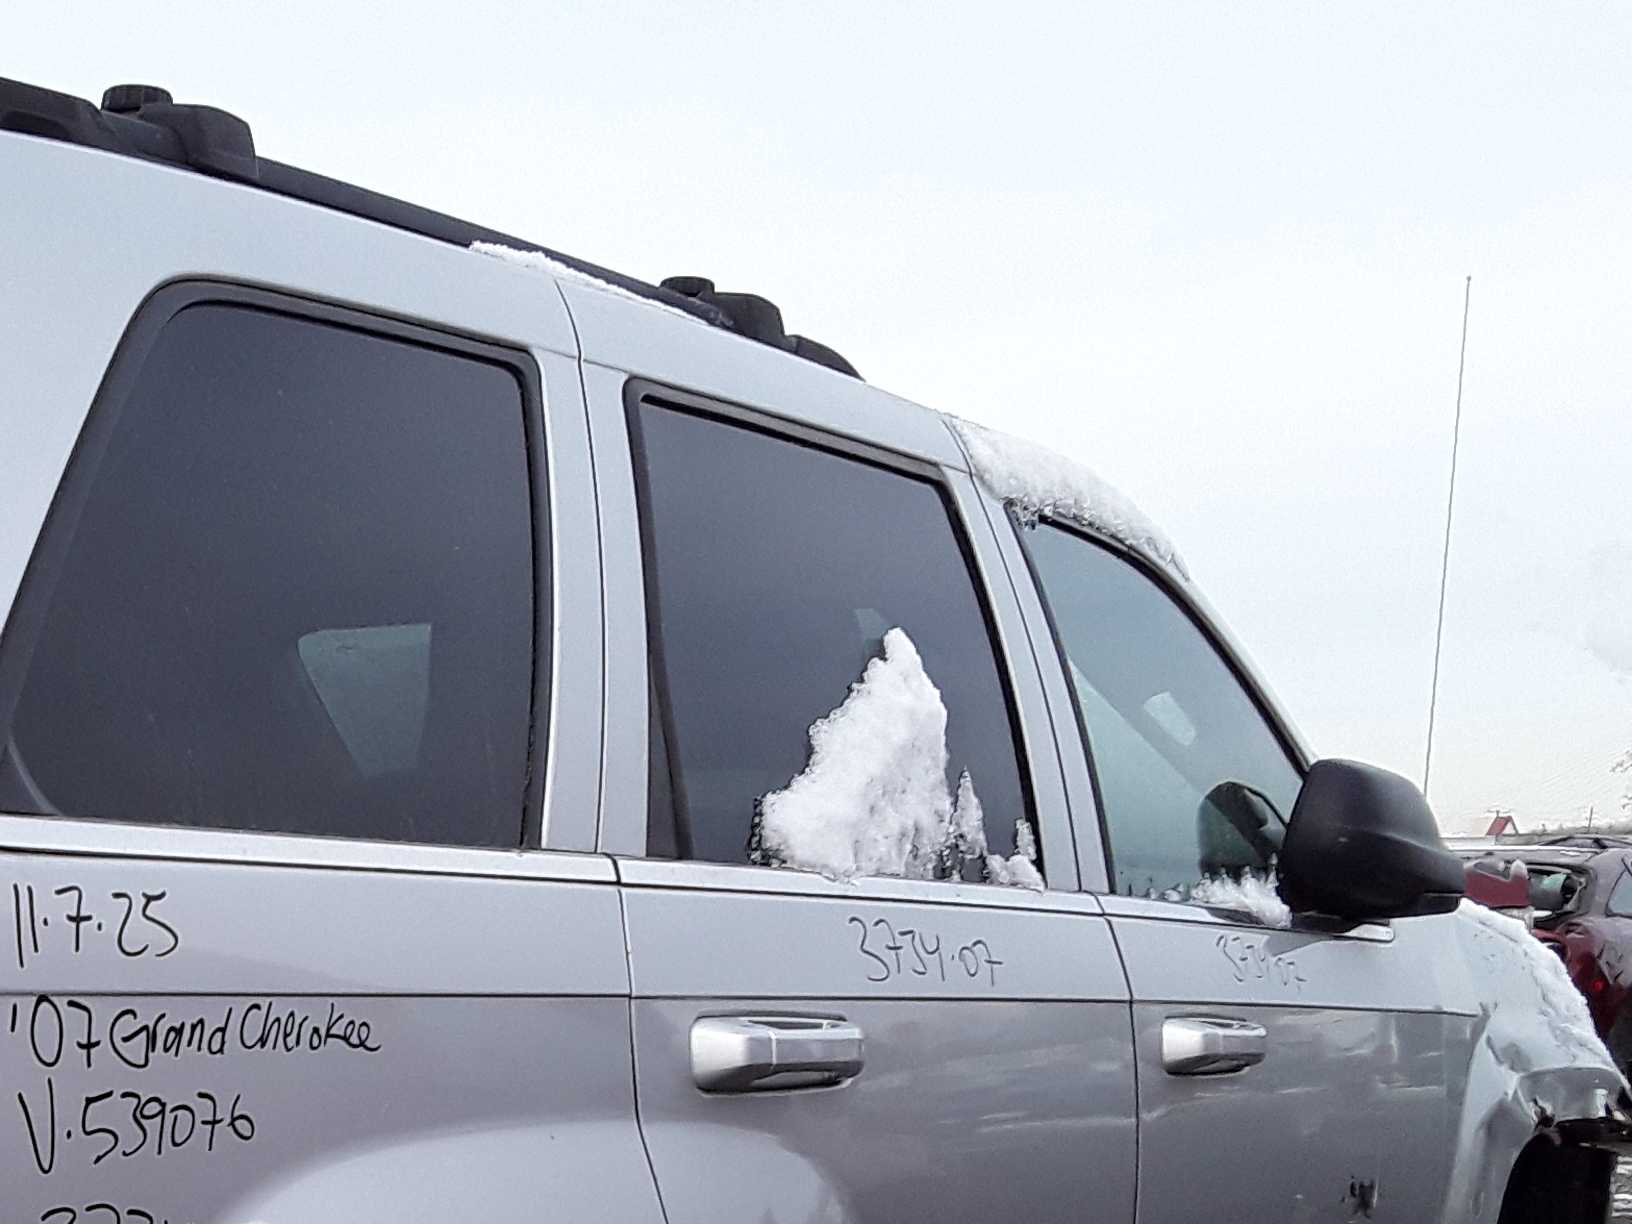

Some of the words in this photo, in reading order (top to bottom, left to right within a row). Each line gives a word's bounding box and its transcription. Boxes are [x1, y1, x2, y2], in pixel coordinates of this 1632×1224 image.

[13, 883, 179, 968] 11.7.25
[849, 917, 1003, 986] 3734.07
[10, 994, 102, 1069] '07
[109, 1007, 233, 1069] Grand
[240, 1000, 382, 1054] Cherokee
